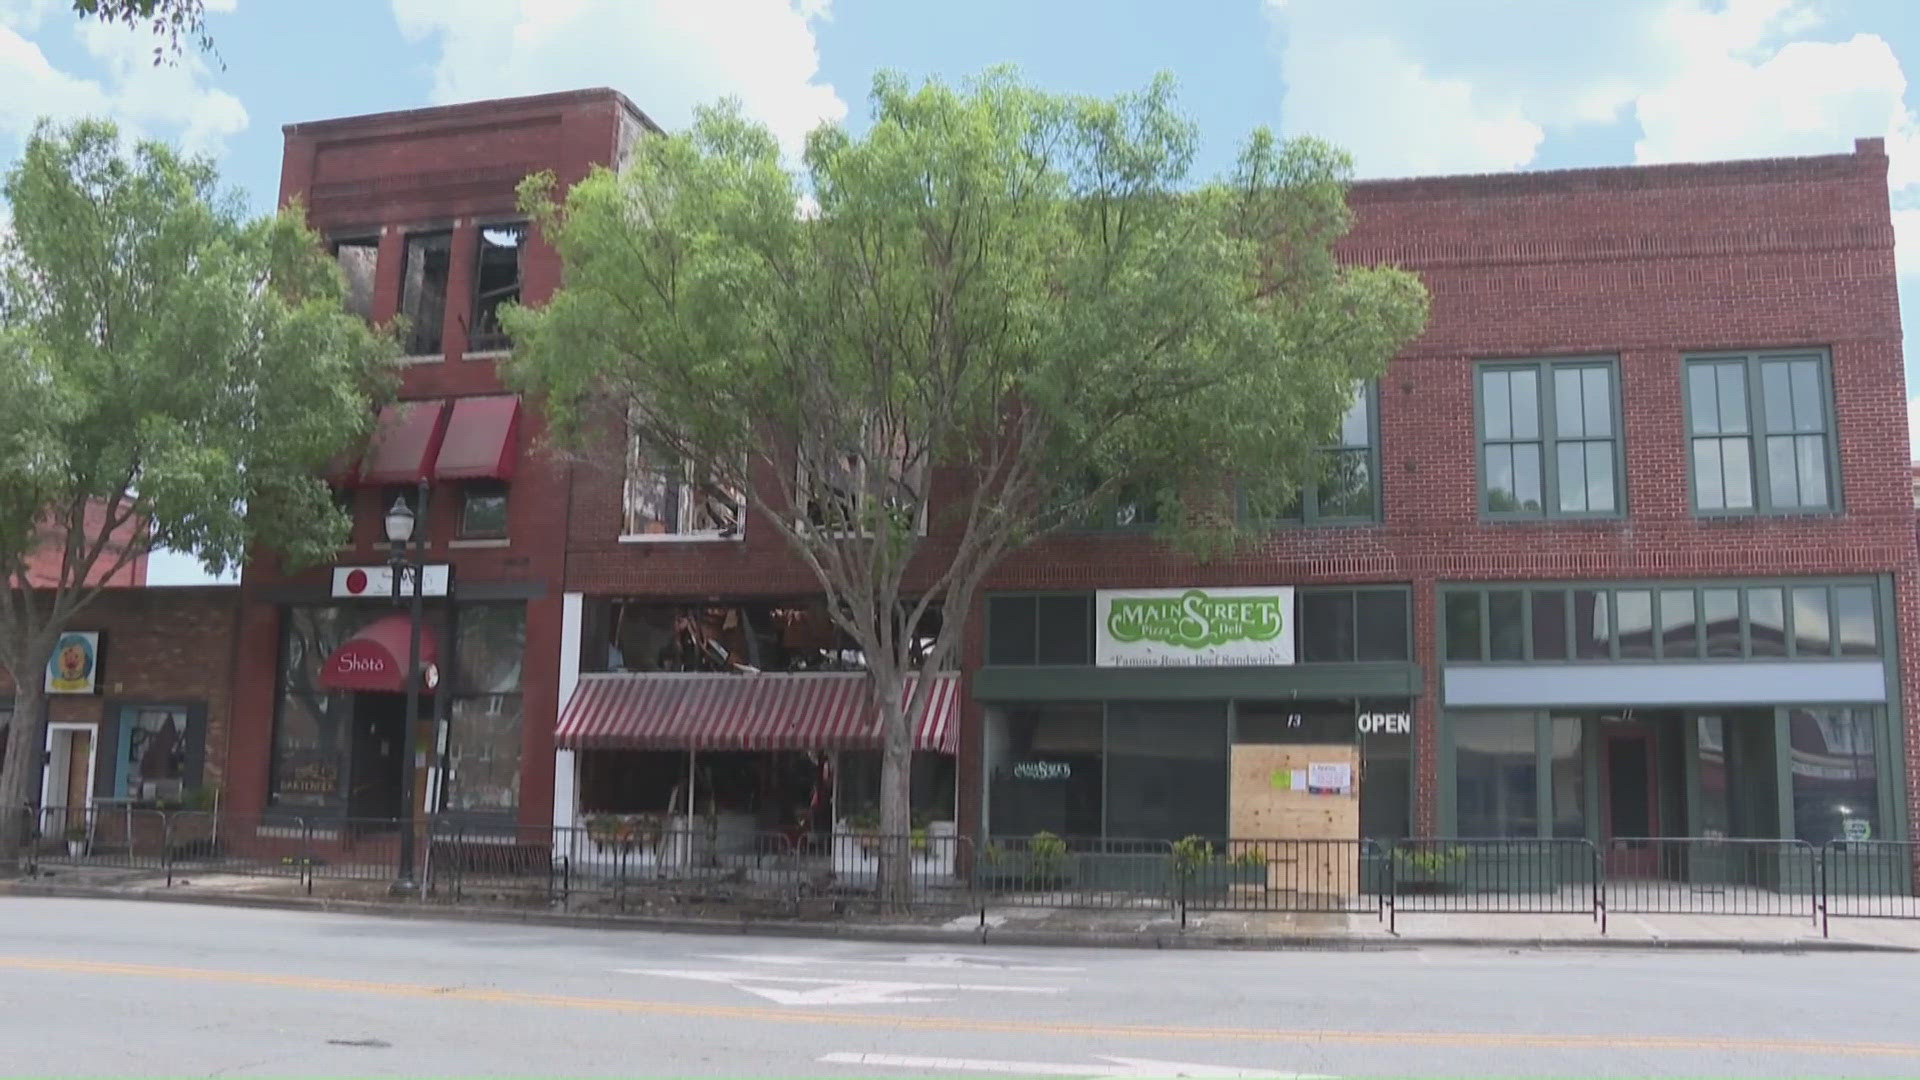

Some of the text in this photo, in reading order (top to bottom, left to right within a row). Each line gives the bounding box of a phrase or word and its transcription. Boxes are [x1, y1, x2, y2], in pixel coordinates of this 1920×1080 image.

[1122, 604, 1182, 624] MAIN
[1141, 624, 1171, 636] Pizza
[1219, 622, 1242, 635] Deli
[1358, 713, 1411, 734] OPEN
